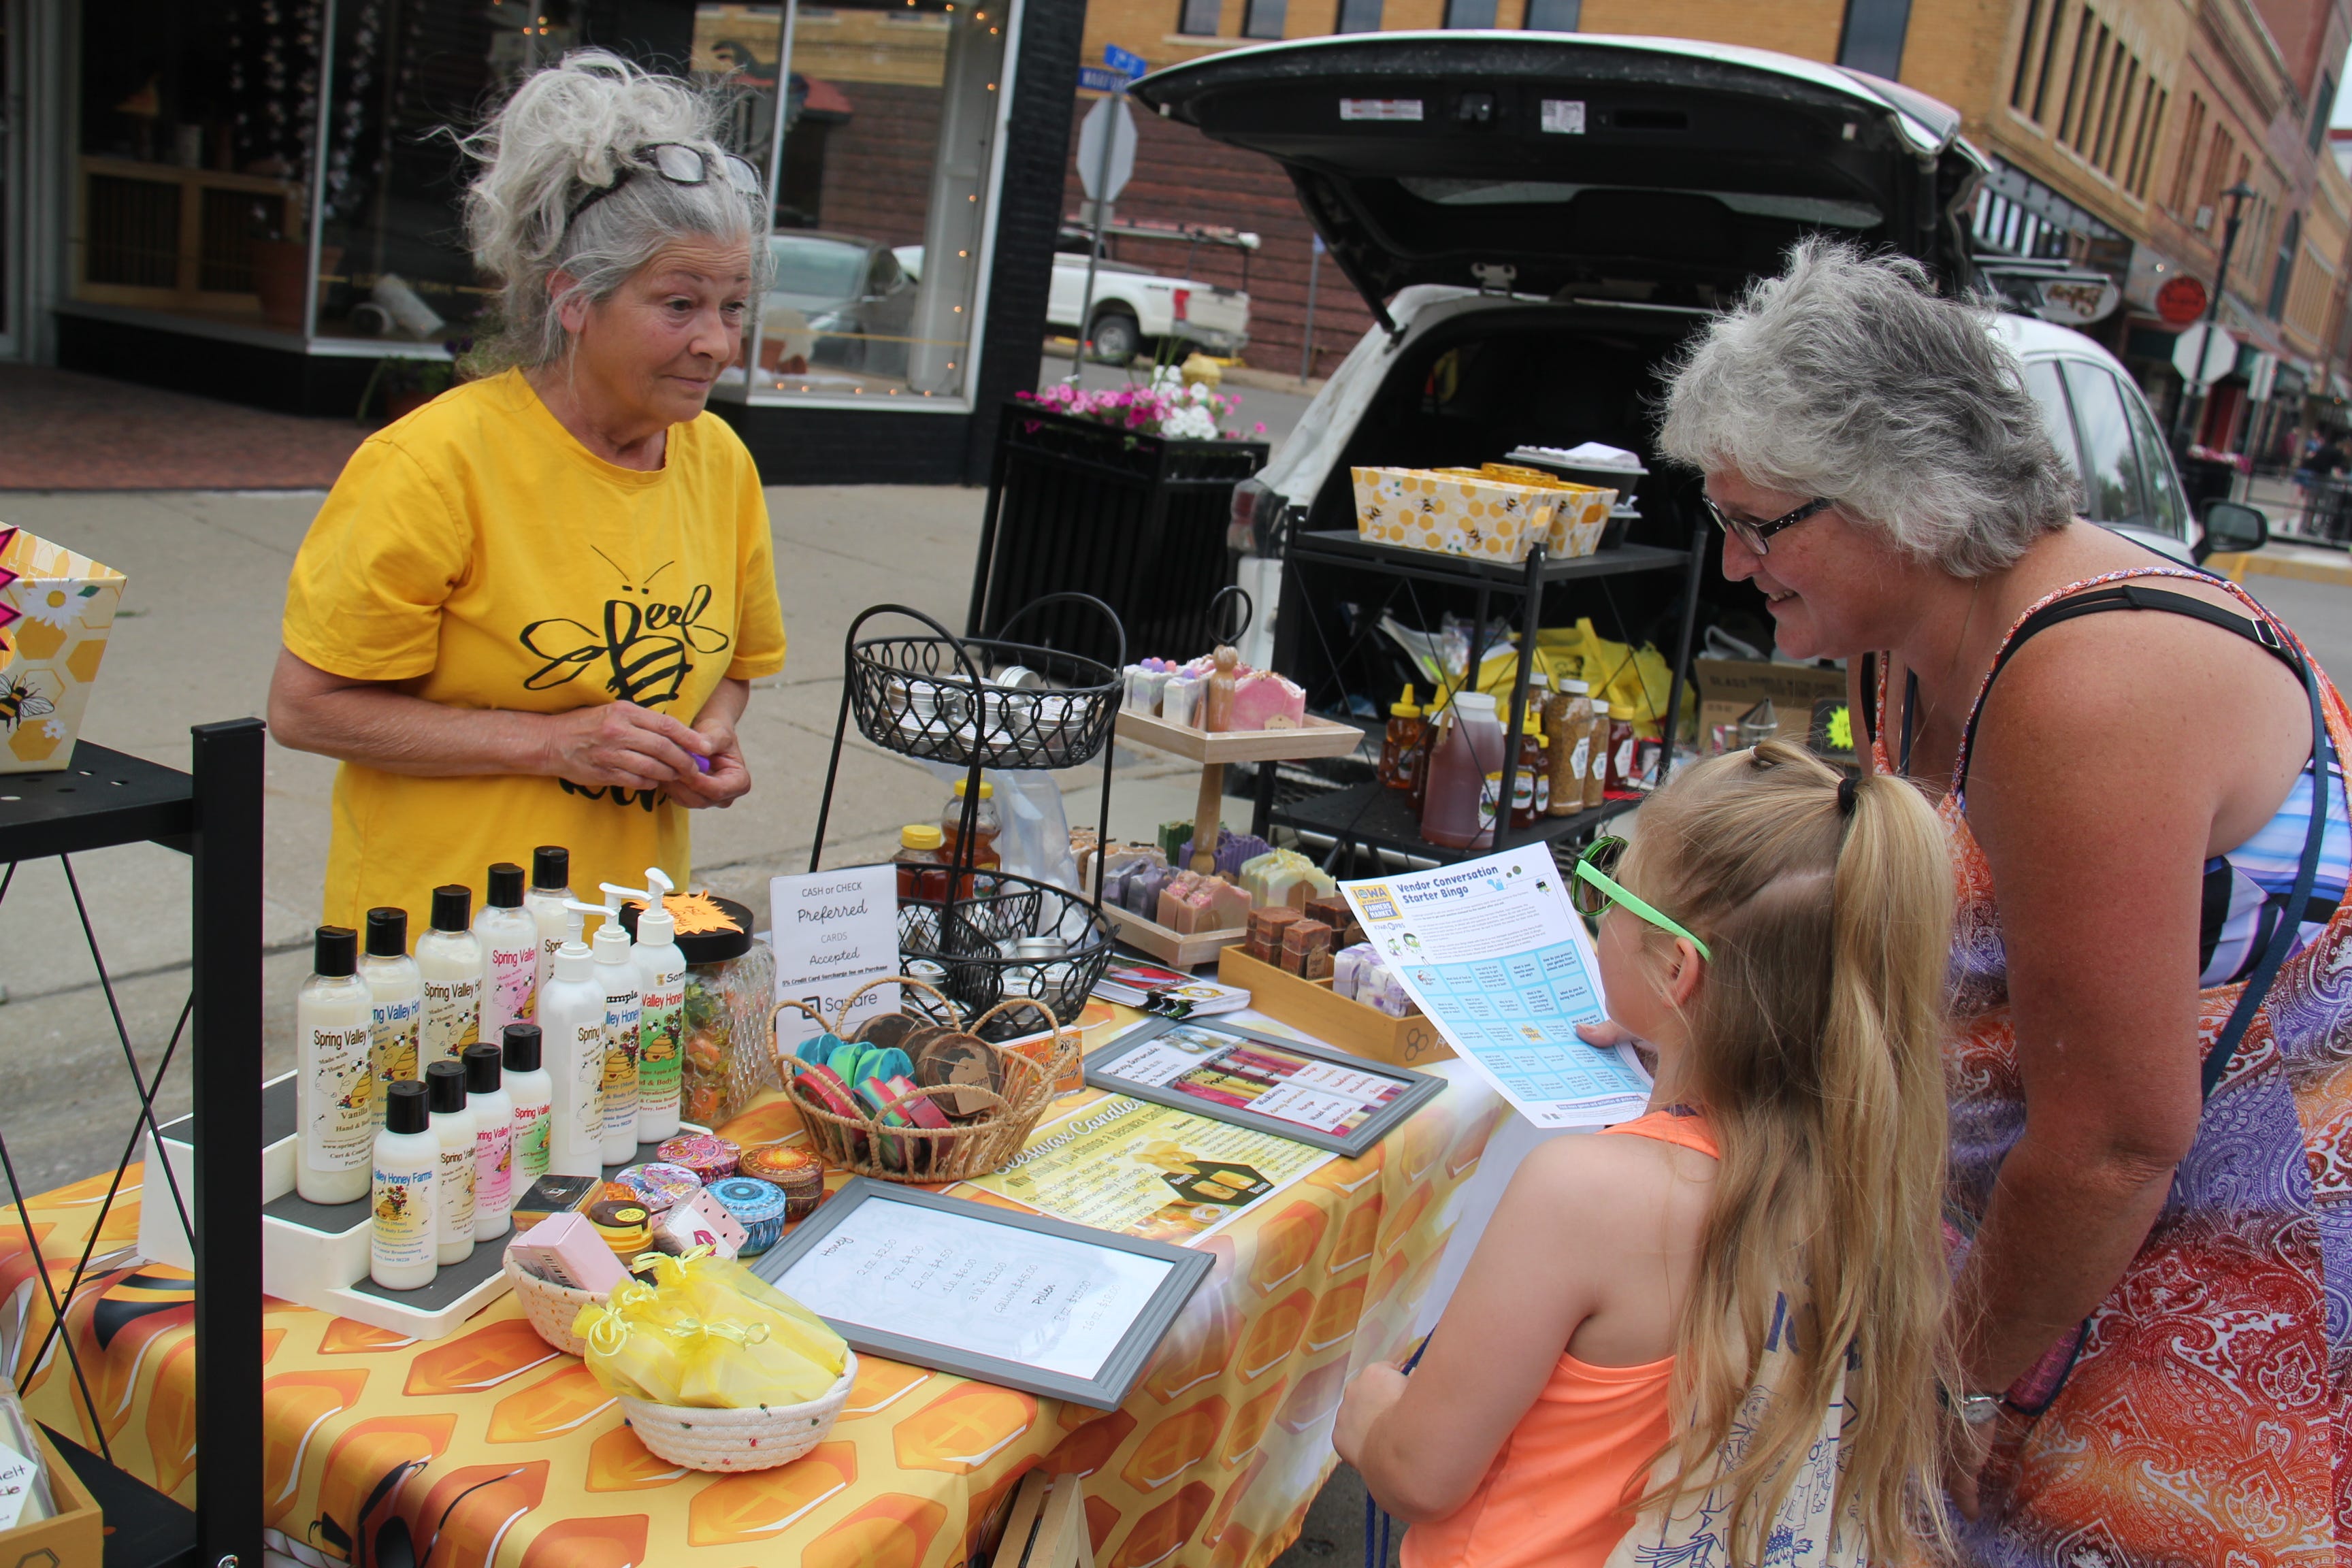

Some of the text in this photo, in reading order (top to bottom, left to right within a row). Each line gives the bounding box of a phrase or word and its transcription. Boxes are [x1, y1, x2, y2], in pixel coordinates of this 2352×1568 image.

[1396, 865, 1499, 893] Vendor Conversation
[802, 881, 862, 898] CASH or CHECK
[1354, 886, 1387, 899] IOWA
[1403, 885, 1469, 904] Starter Bingo
[798, 898, 868, 924] Preferred
[1364, 902, 1392, 911] FARMERS
[1369, 909, 1394, 919] MARKET
[821, 932, 847, 944] CARDS
[493, 950, 517, 967] Spring
[809, 947, 860, 966] Accepted
[791, 976, 807, 985] Credit
[821, 971, 847, 981] Surcharge
[865, 964, 887, 973] Purchase
[425, 982, 449, 1002] Spring
[452, 983, 474, 998] Valley
[606, 990, 638, 1004] ample
[642, 994, 664, 1010] Valley
[825, 993, 878, 1012] Sqare
[387, 1004, 410, 1021] Valley
[606, 1009, 622, 1028] lley
[314, 1030, 342, 1050] Spring
[344, 1029, 366, 1046] Valley
[578, 1024, 600, 1045] Spring
[318, 1051, 348, 1065] Made with
[328, 1063, 346, 1073] Honey
[657, 1077, 672, 1086] Body
[515, 1108, 536, 1120] Spring
[1068, 1098, 1147, 1135] Candles
[336, 1124, 353, 1132] Hand
[493, 1126, 508, 1139] Valley
[1006, 1175, 1035, 1188] Why
[1028, 1160, 1062, 1178] should
[1073, 1139, 1108, 1156] choose
[1105, 1118, 1147, 1138] beeswax
[388, 1170, 432, 1186] Honey Farms
[821, 1237, 854, 1257] Honey
[1031, 1283, 1056, 1305] Pollen
